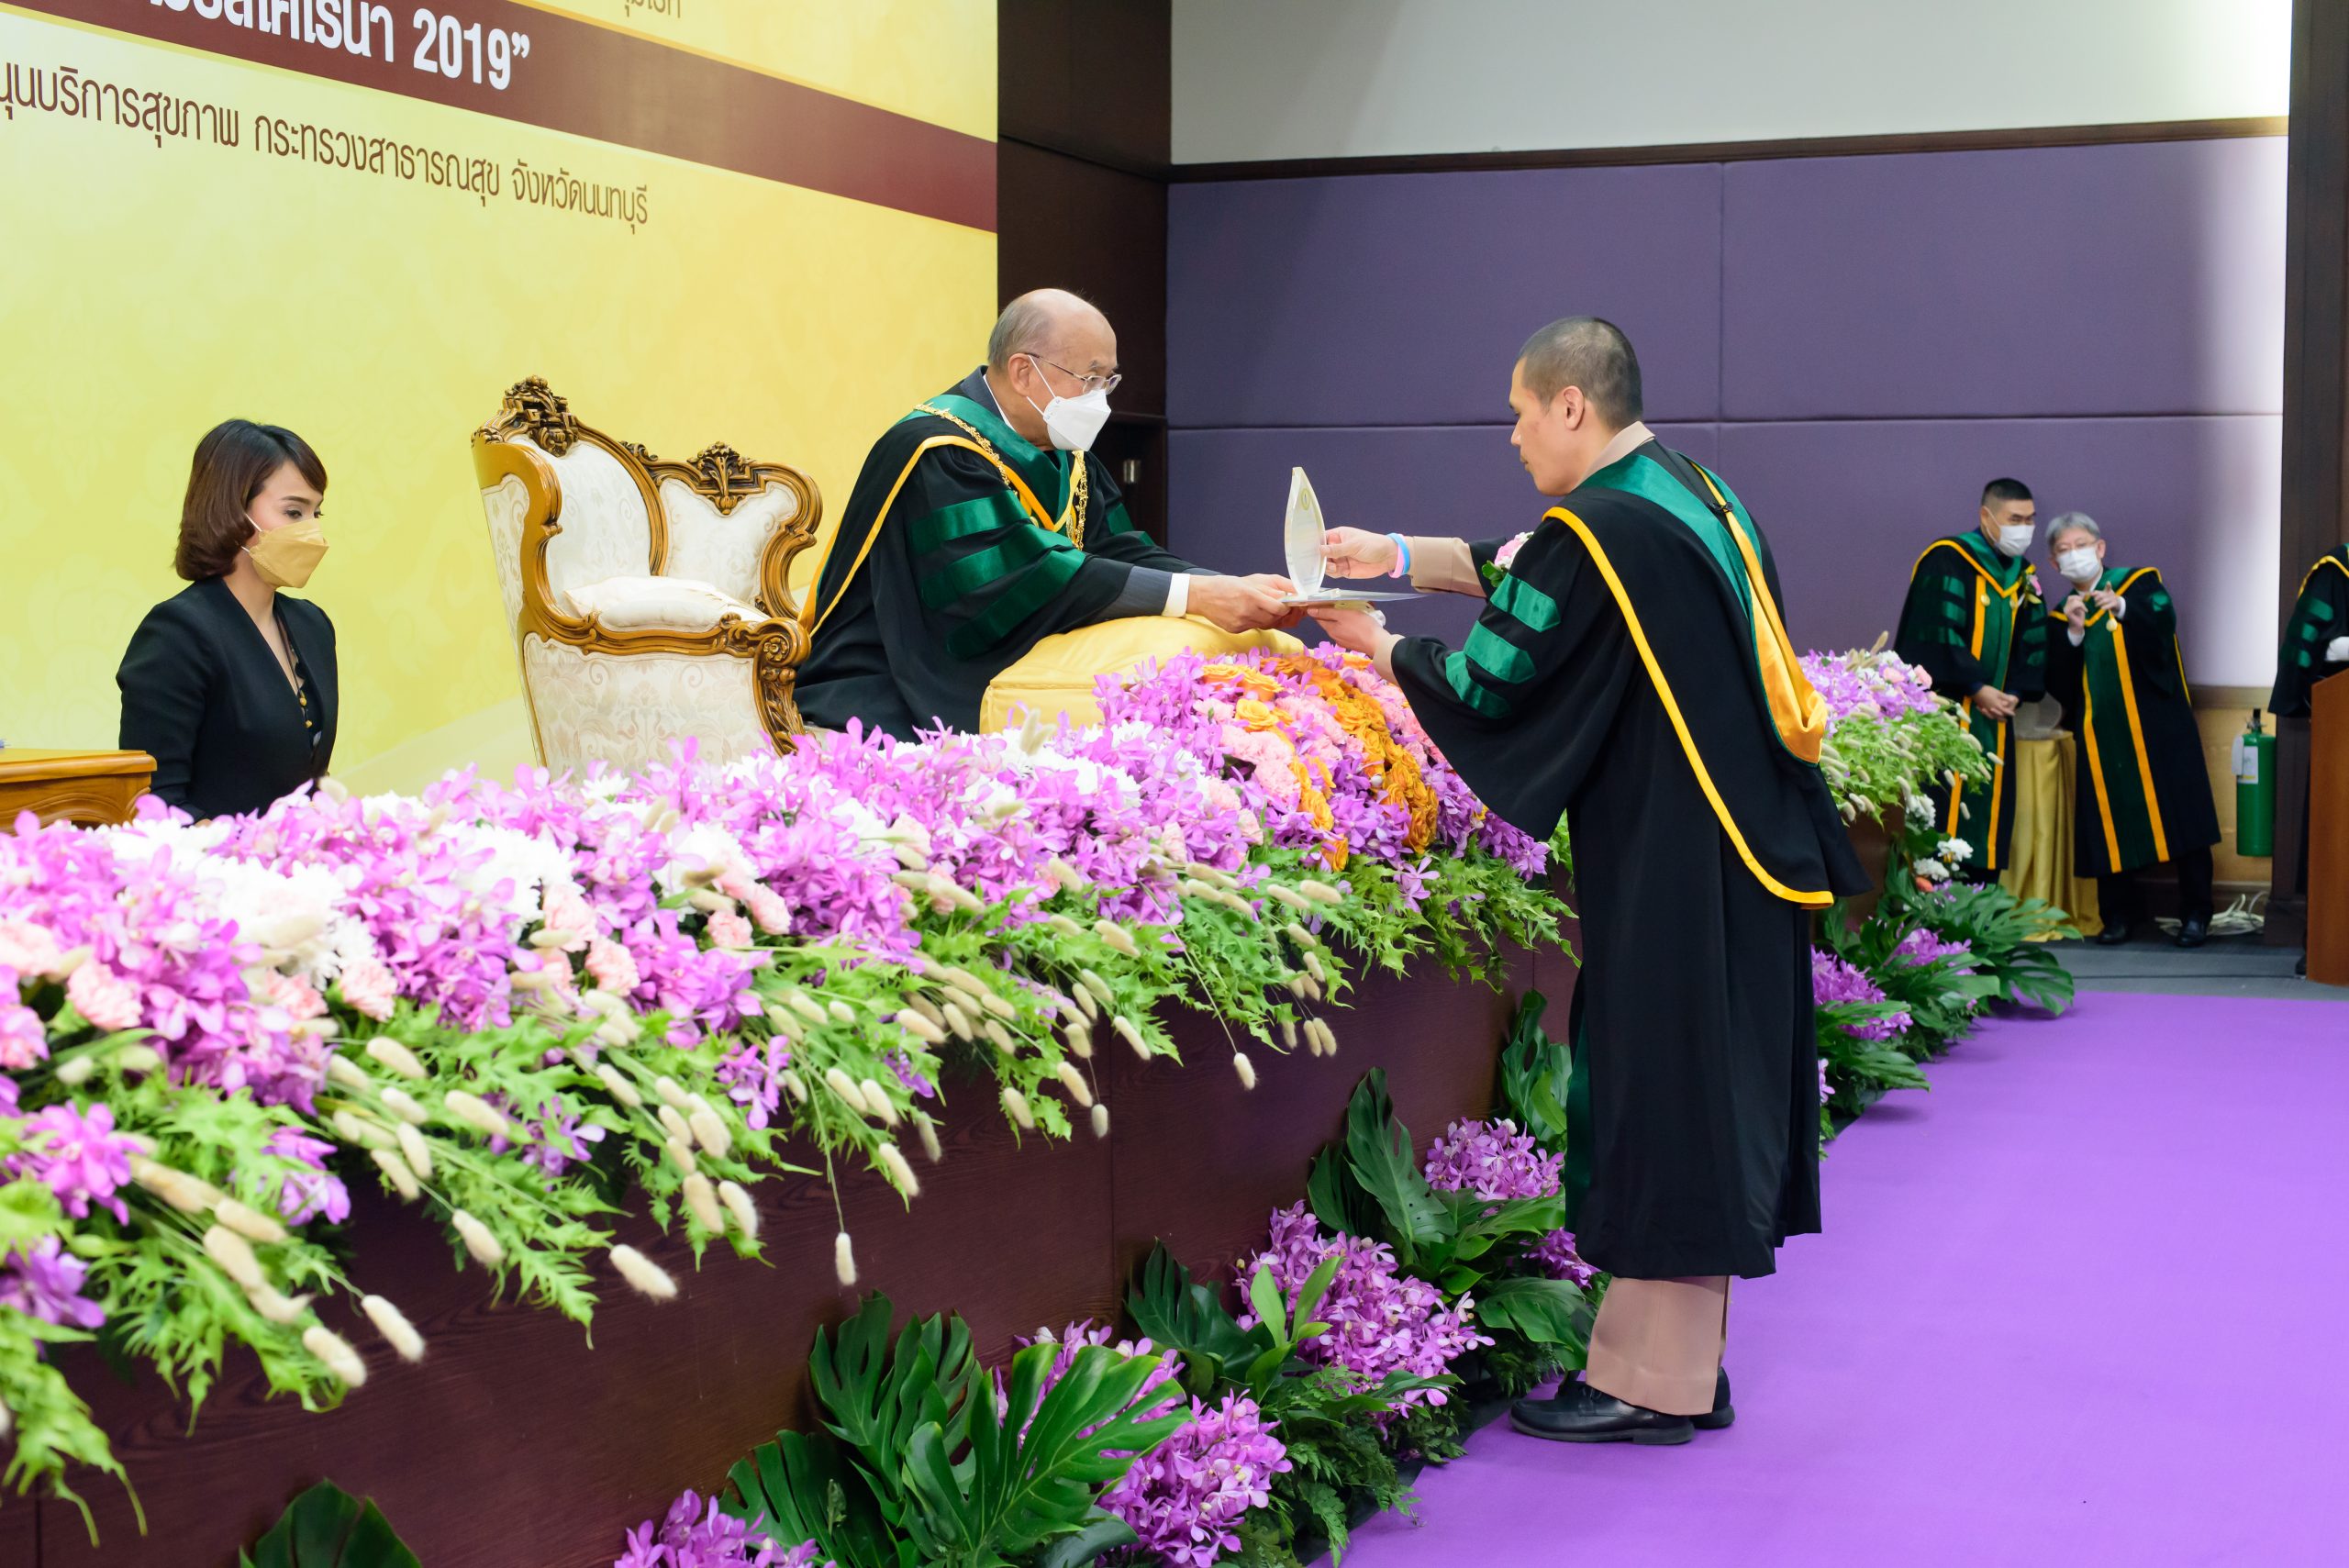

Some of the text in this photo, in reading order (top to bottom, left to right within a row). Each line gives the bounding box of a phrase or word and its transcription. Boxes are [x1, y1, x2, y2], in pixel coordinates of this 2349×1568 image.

[254, 115, 500, 207] กระทรวงสาธารณสุข
[511, 158, 648, 235] จังหวัดนนทบุรี
